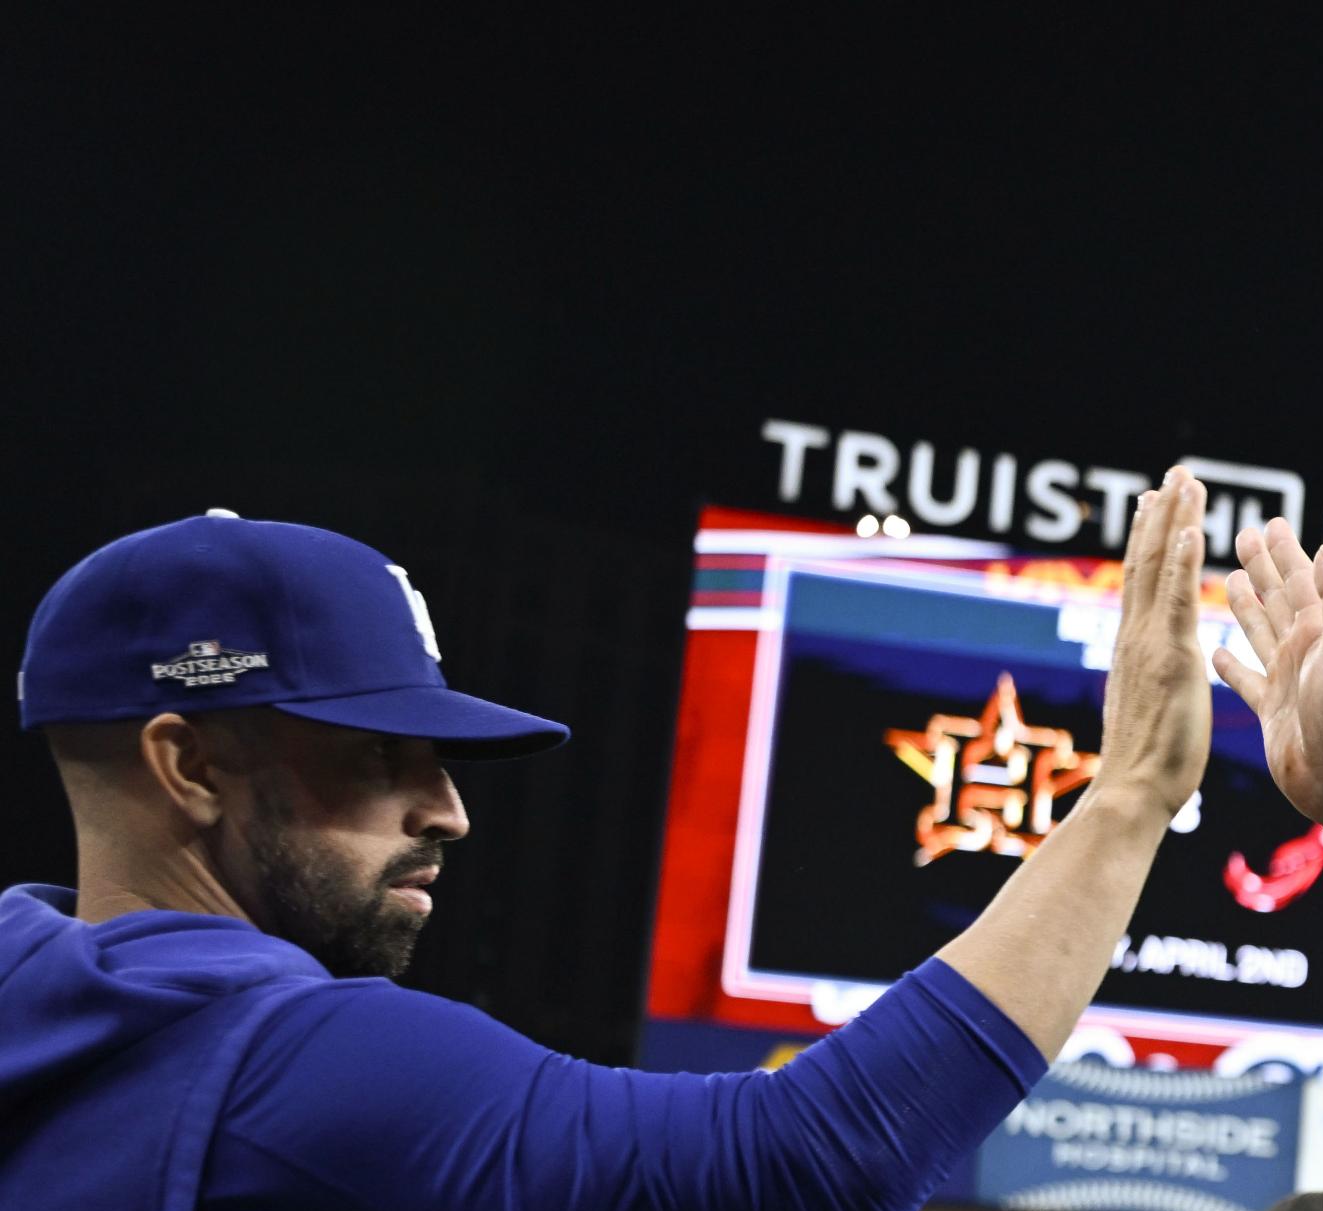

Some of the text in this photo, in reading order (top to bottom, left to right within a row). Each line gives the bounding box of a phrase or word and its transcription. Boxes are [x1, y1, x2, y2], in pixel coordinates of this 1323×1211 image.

[761, 418, 1152, 549] TRUIST
[151, 654, 269, 679] POSTSEASON
[1136, 935, 1237, 982] APRIL
[1235, 944, 1309, 988] 2ND
[1004, 1098, 1280, 1160] NORTHSIDE
[1051, 1142, 1229, 1183] HOSPITAL
